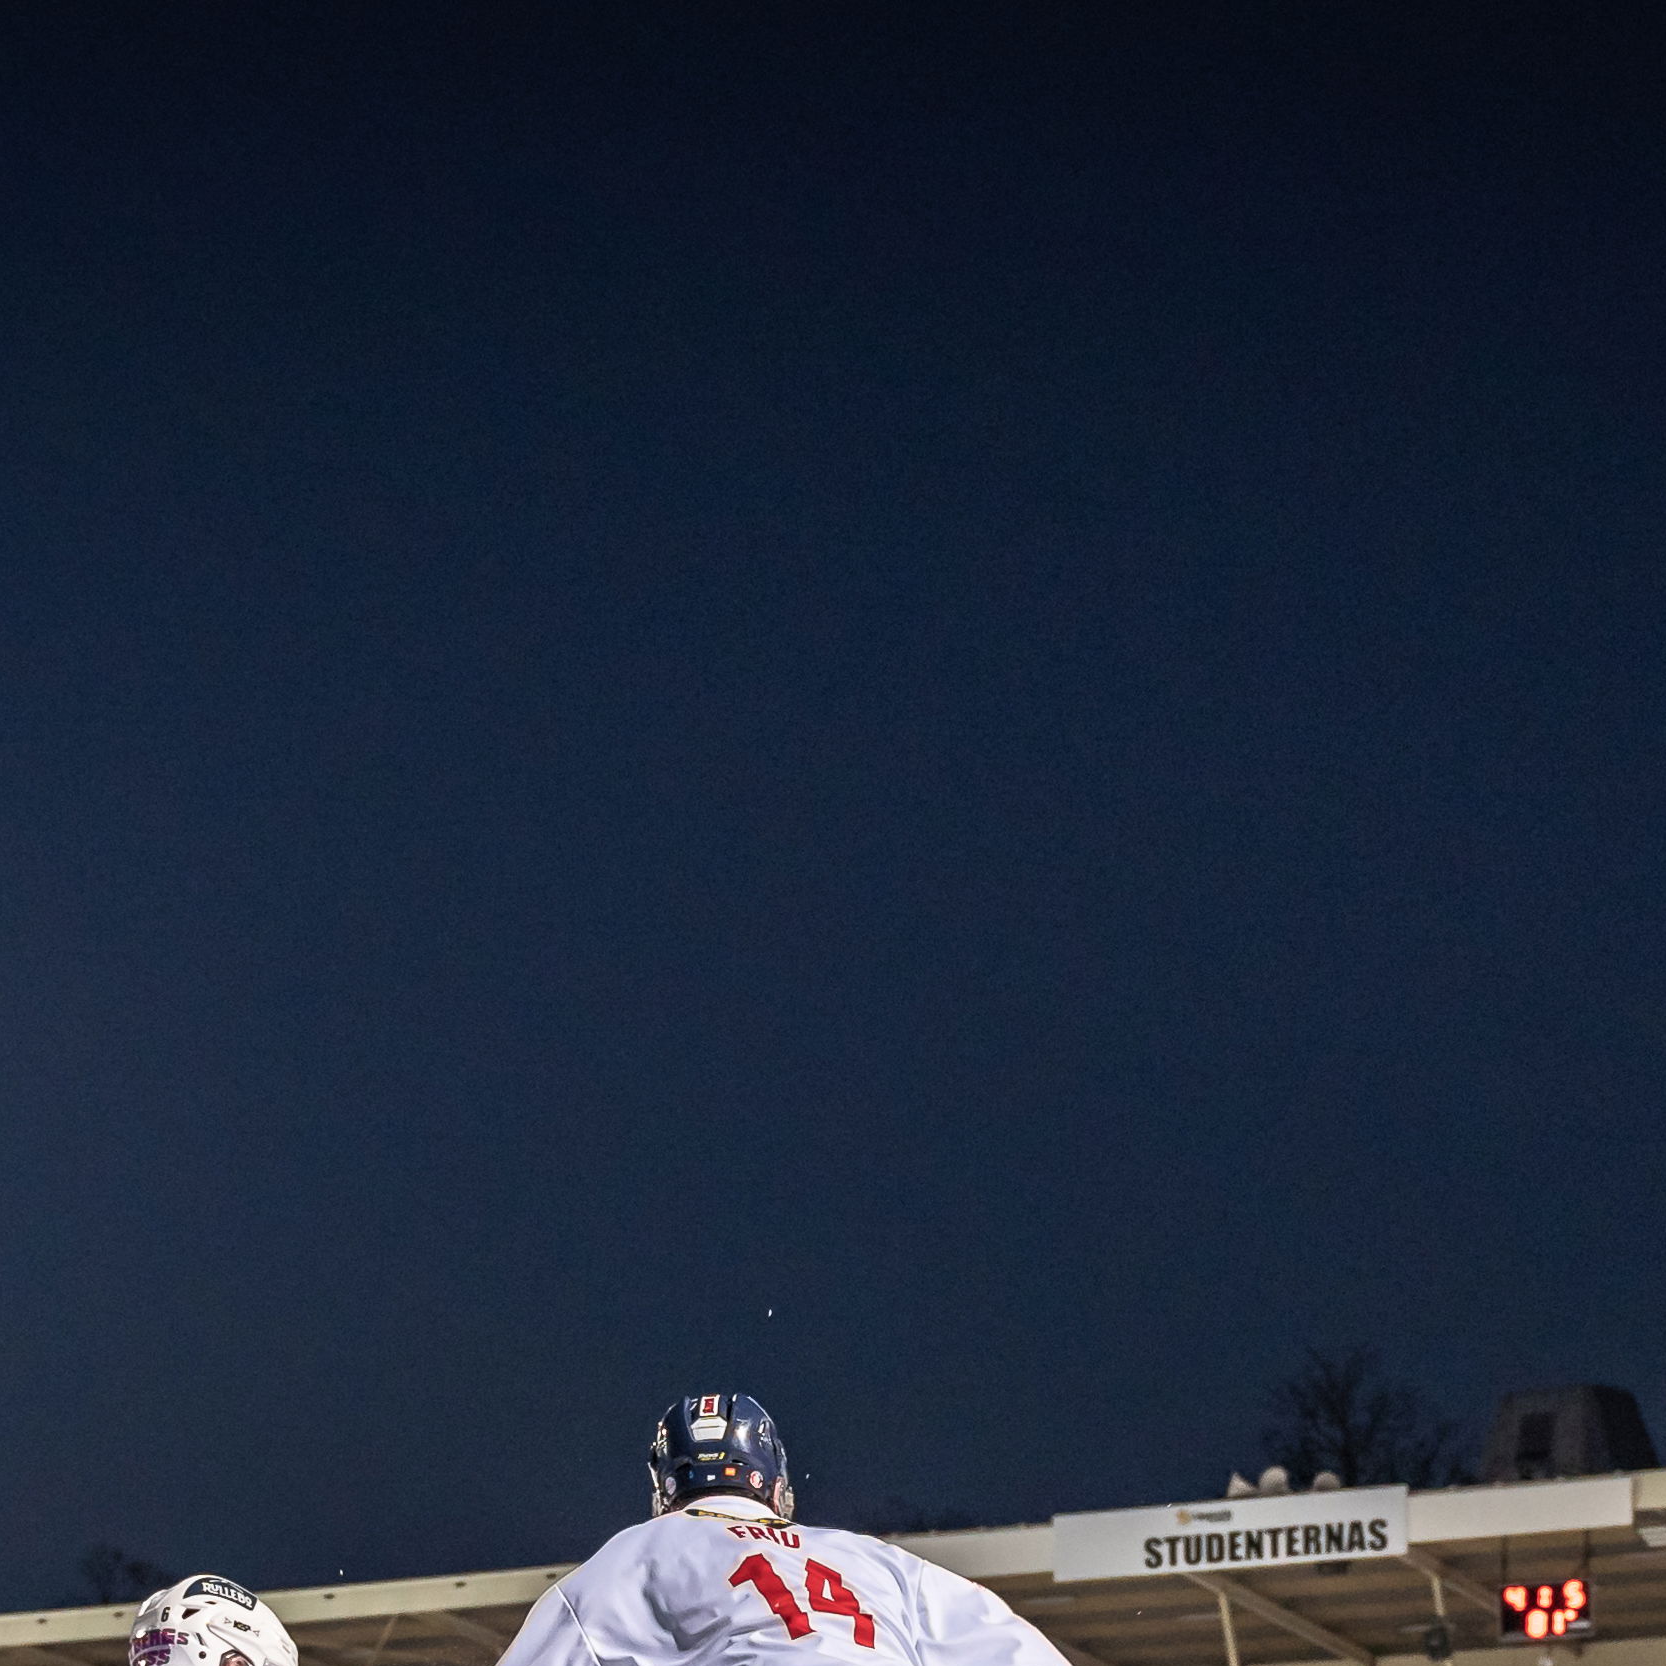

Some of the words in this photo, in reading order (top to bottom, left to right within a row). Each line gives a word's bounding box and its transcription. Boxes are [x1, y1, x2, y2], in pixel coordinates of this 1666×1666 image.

[1144, 1518, 1389, 1569] STUDENTERNAS
[161, 1607, 170, 1622] 6
[728, 1553, 876, 1649] 14
